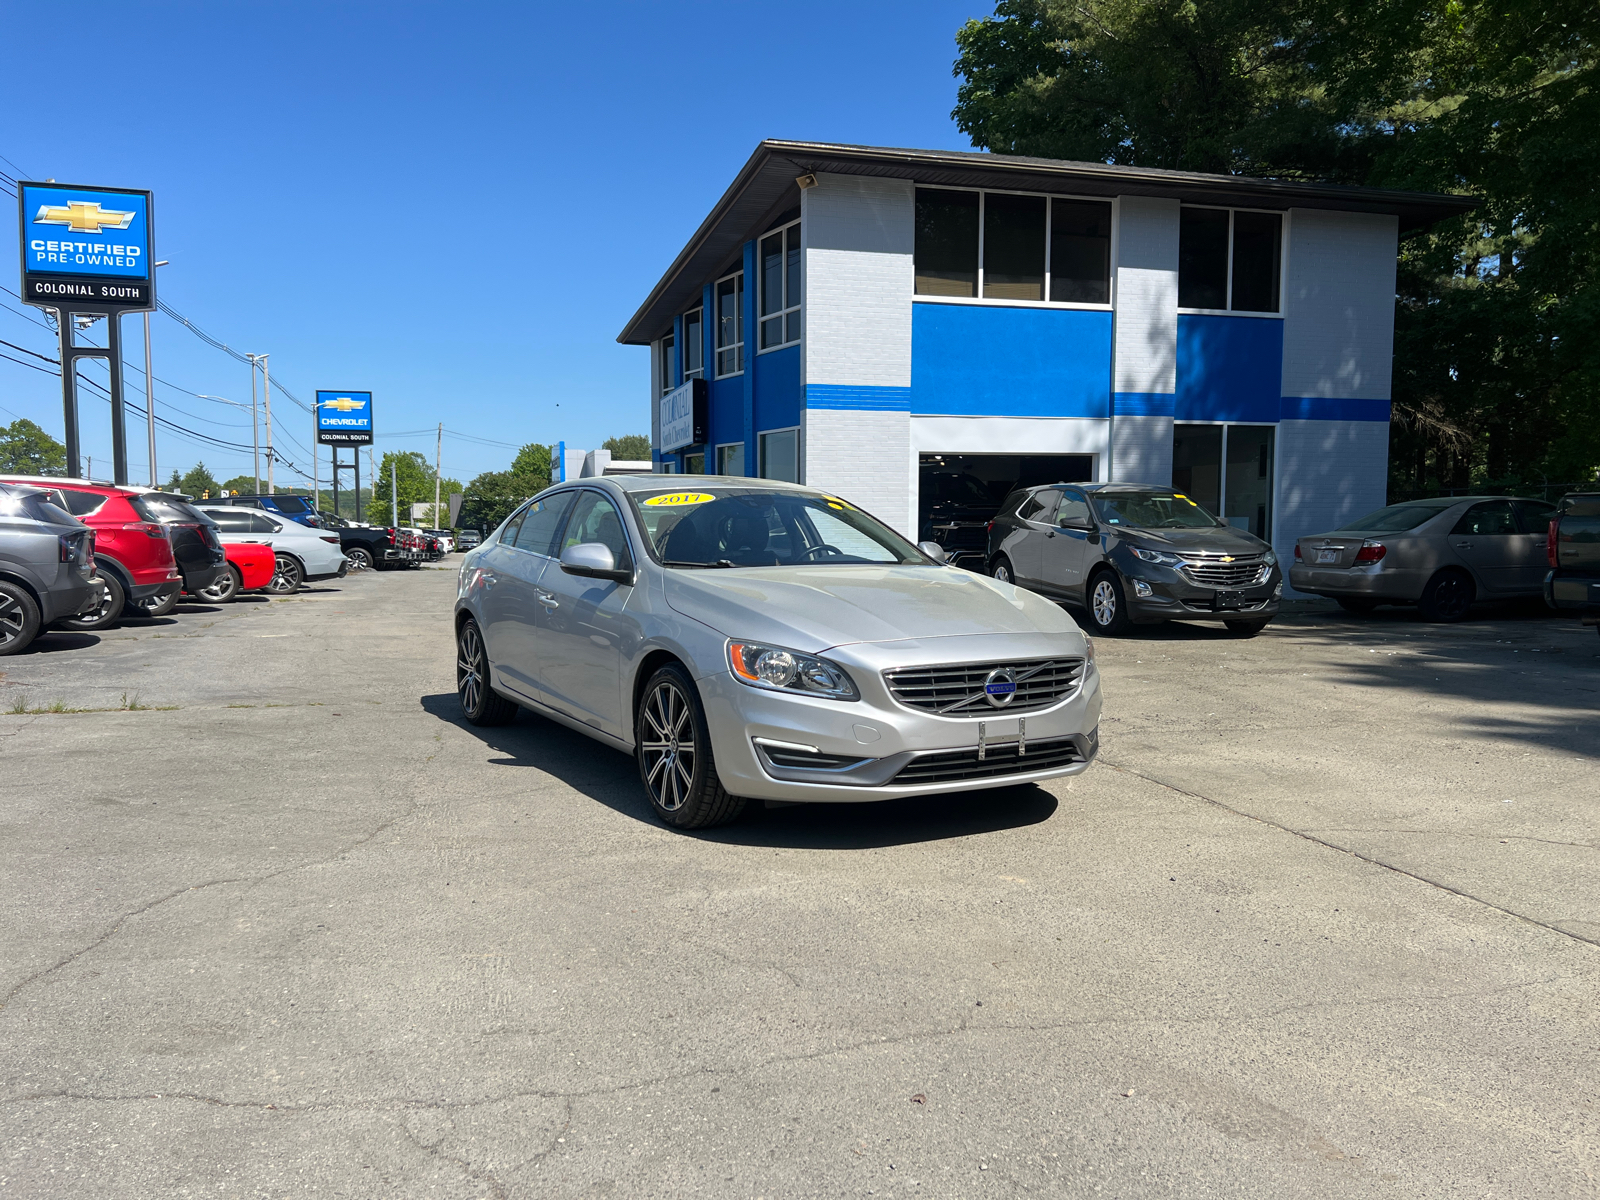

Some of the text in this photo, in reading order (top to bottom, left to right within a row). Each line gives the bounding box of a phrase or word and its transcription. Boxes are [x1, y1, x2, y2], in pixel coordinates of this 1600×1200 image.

[30, 239, 141, 257] CERTIFIED
[36, 251, 136, 268] PRE-OWNED
[35, 282, 140, 298] COLONIAL SOUTH
[658, 494, 700, 504] 2017
